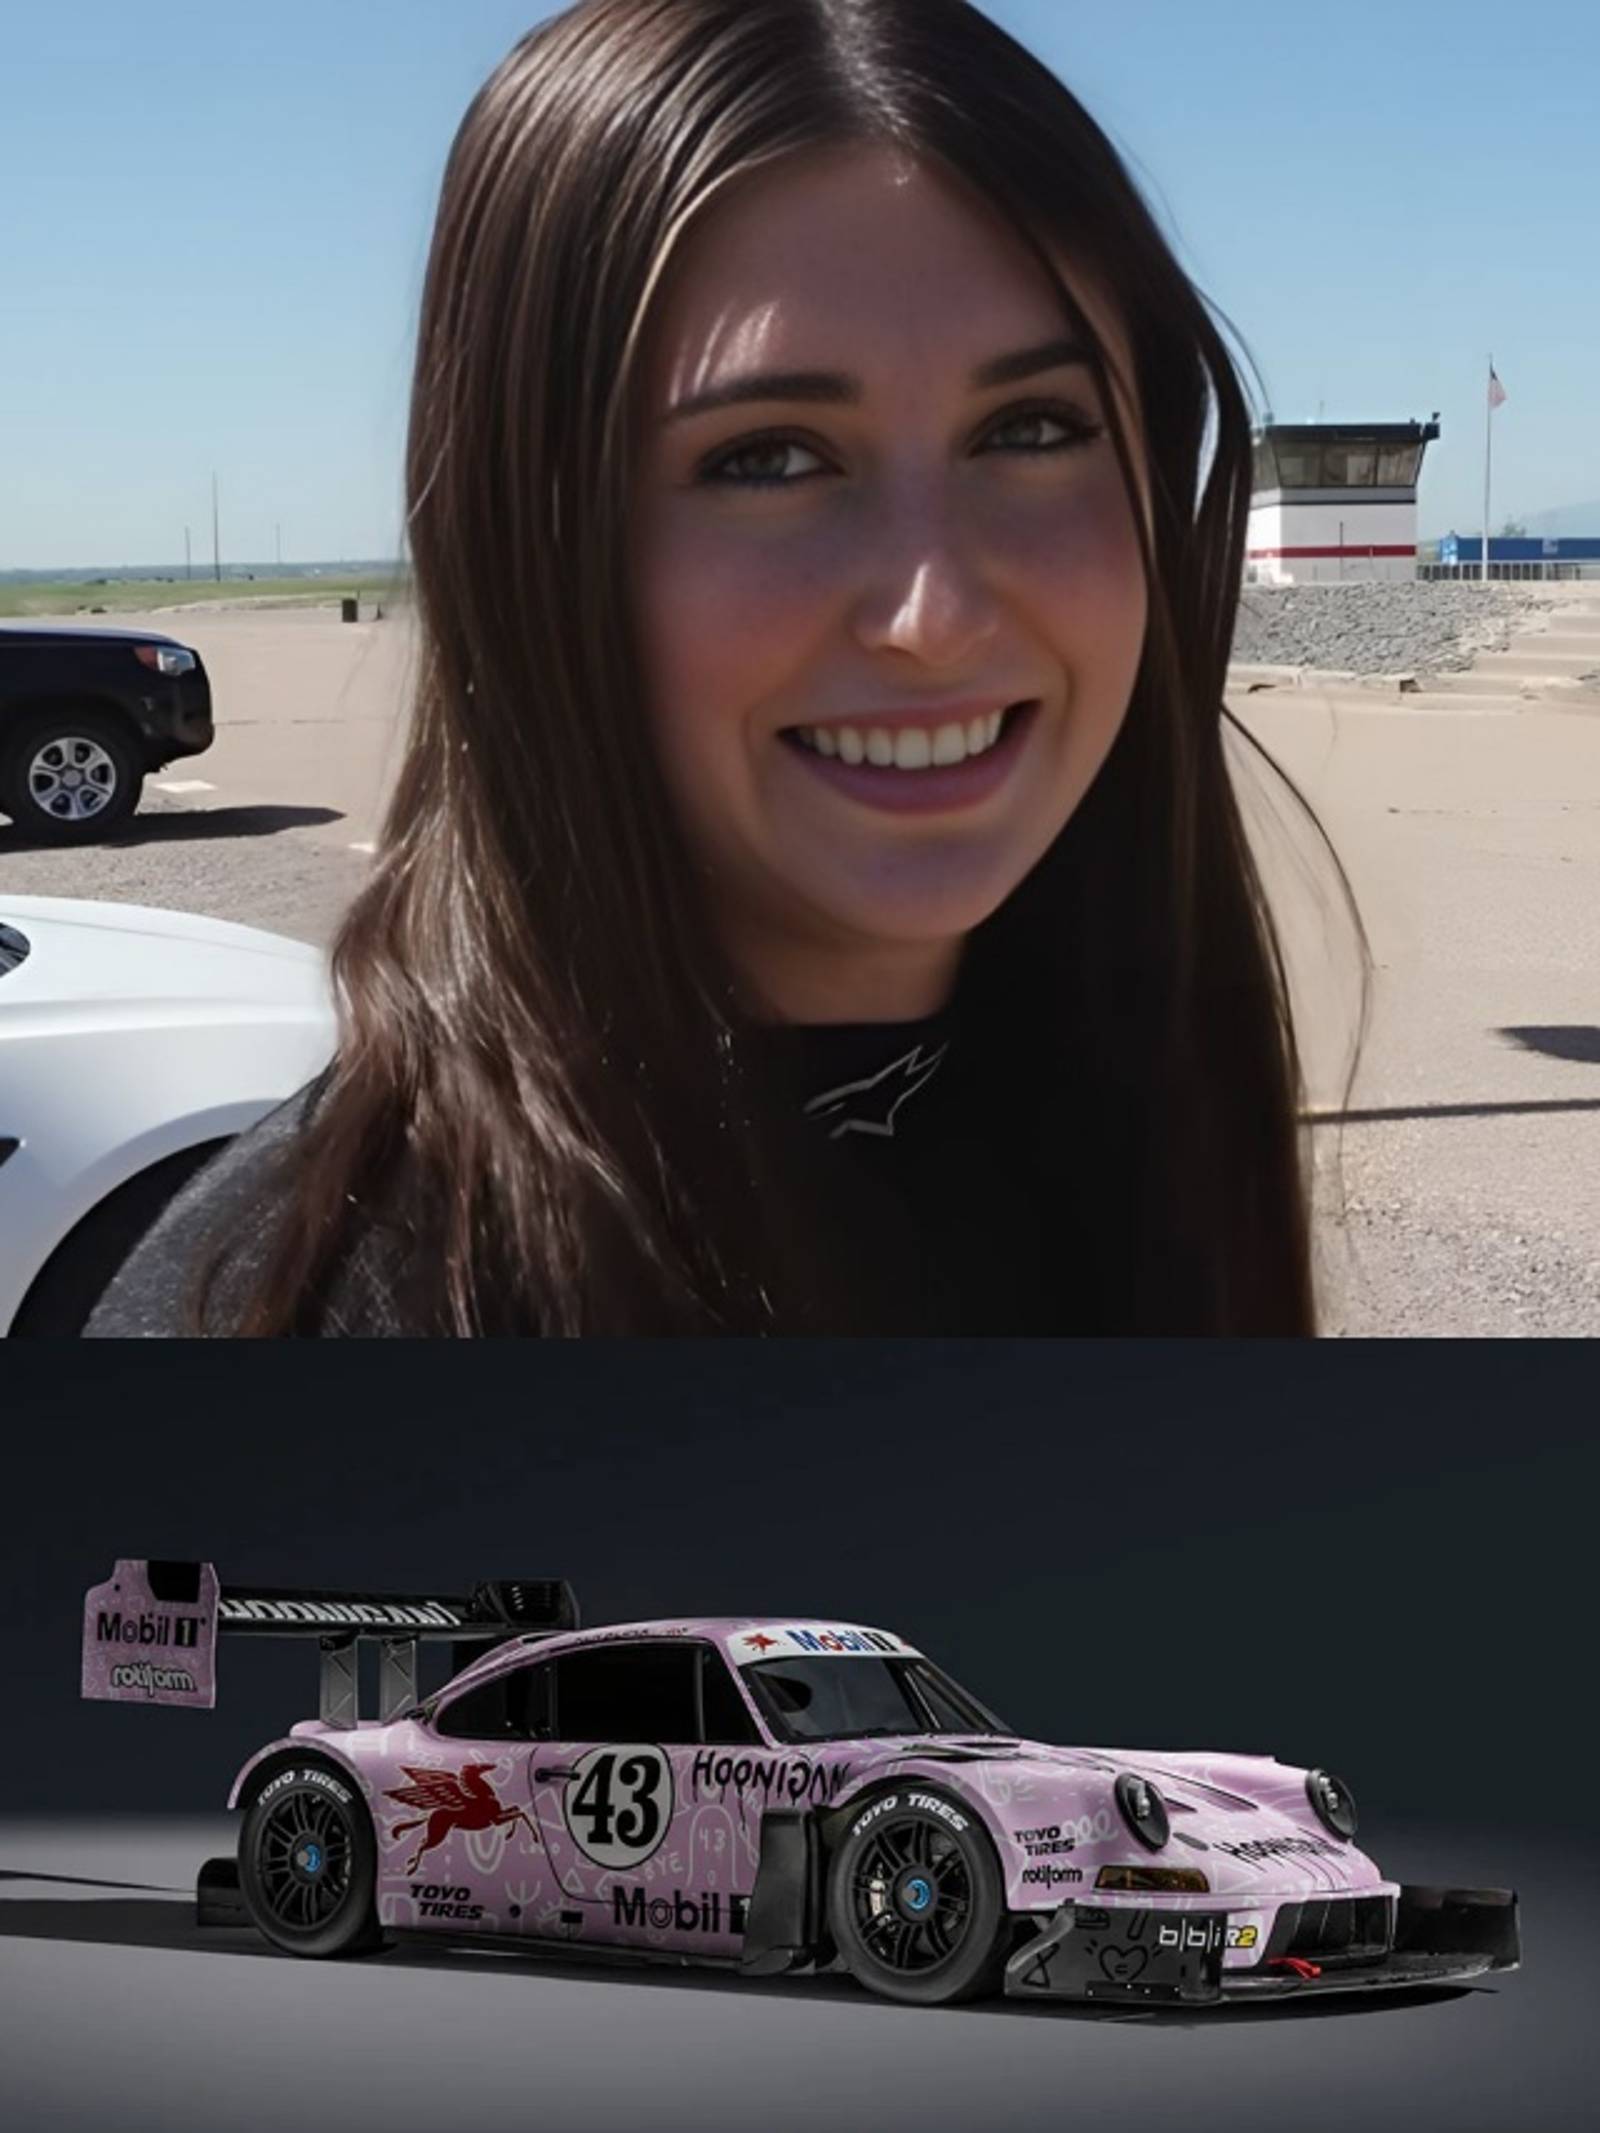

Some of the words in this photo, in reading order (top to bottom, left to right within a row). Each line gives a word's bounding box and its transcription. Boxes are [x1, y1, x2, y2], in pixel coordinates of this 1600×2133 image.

[98, 1611, 169, 1646] Mobil
[785, 1630, 877, 1652] Mobil
[111, 1660, 197, 1697] rotiform
[258, 1769, 295, 1806] TOYO
[692, 1750, 851, 1808] HOONIGAN
[572, 1753, 661, 1848] 43
[853, 1795, 898, 1836] TOYO
[907, 1792, 969, 1832] TIRES
[1013, 1825, 1060, 1843] TOYO
[1024, 1838, 1075, 1856] TIRES
[410, 1884, 471, 1901] TOYO
[1022, 1865, 1083, 1890] rotiform
[419, 1902, 485, 1919] TIRES
[613, 1885, 719, 1933] Mobil
